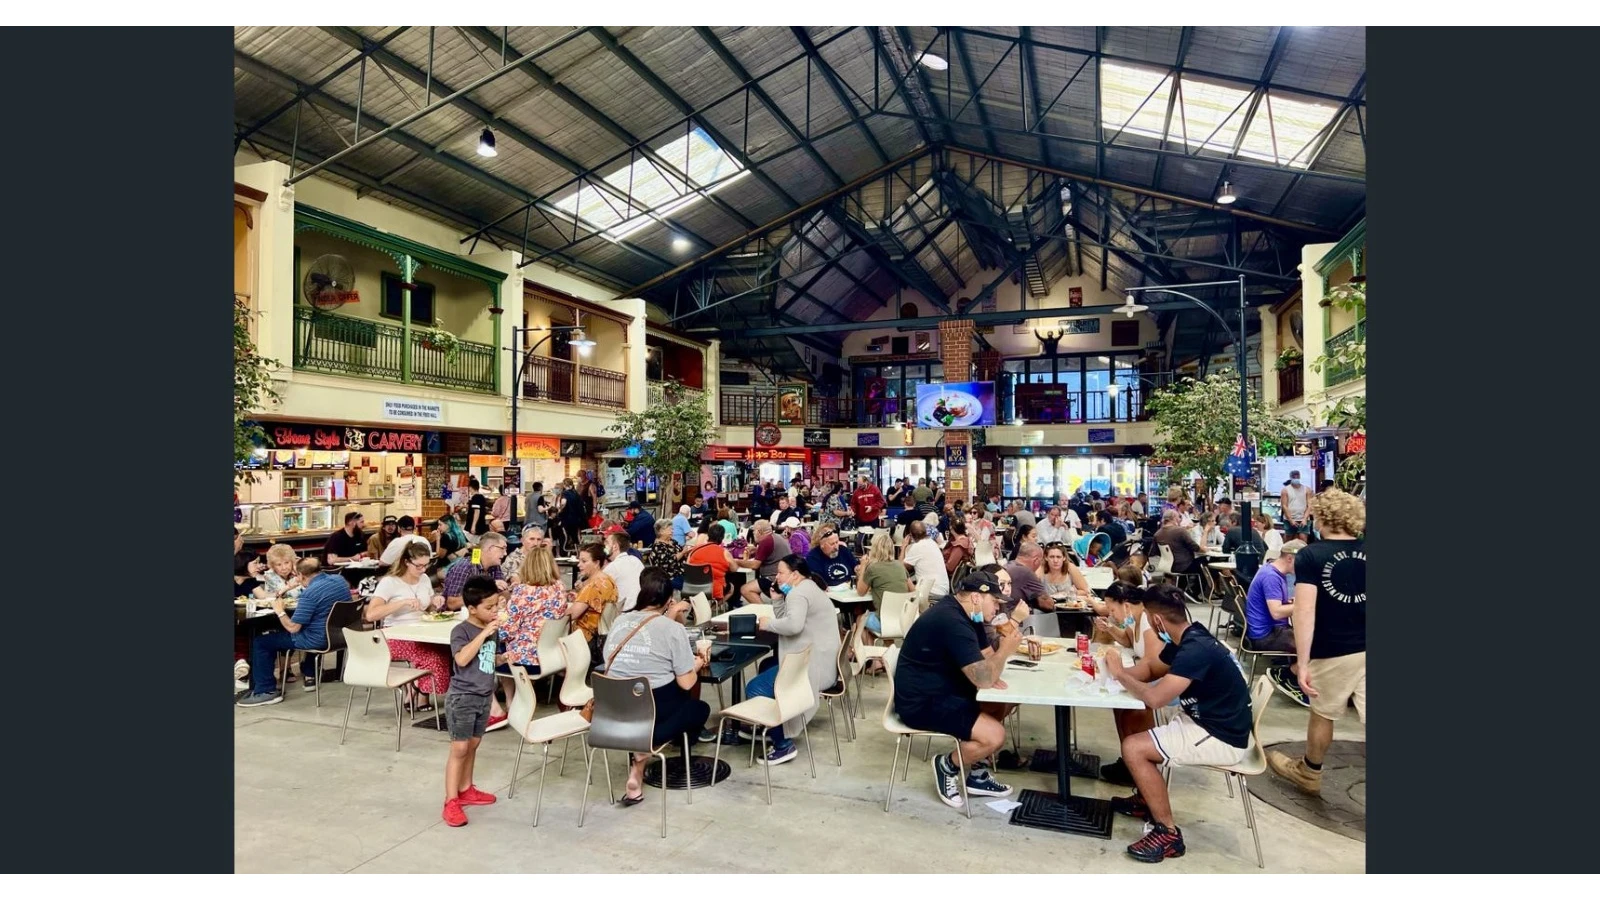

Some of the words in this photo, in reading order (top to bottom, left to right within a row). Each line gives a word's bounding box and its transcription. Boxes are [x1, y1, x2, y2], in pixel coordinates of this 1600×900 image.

[274, 427, 311, 446] Home
[314, 429, 341, 449] Style
[368, 430, 424, 451] CARVERY
[769, 449, 787, 459] Bar
